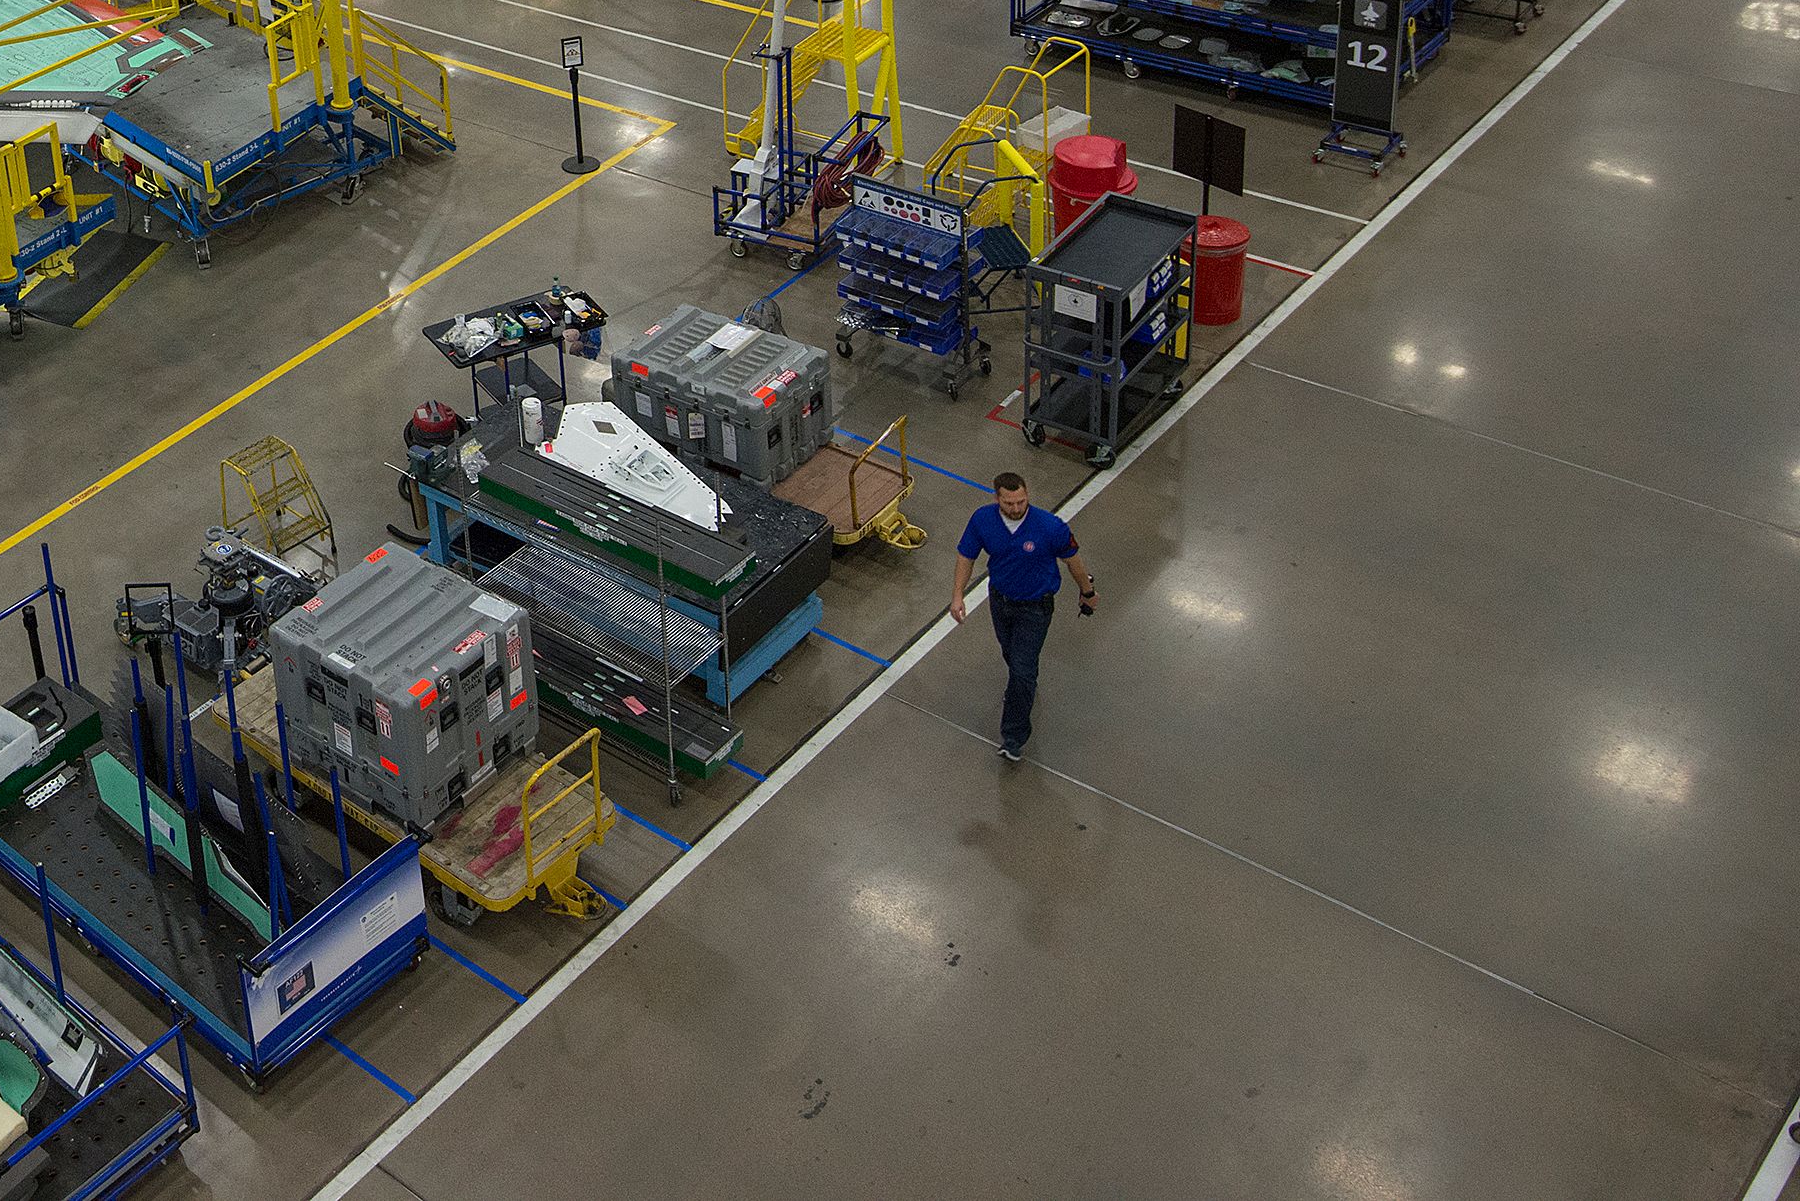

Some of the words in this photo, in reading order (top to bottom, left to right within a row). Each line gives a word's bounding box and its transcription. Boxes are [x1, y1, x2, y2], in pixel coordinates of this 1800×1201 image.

[1347, 41, 1388, 73] 12
[336, 650, 359, 664] STACK
[339, 643, 352, 653] DO
[351, 649, 367, 661] NOT
[323, 677, 334, 687] DO
[333, 682, 348, 696] NOT
[461, 678, 470, 689] DO
[470, 669, 483, 683] NOT
[463, 678, 483, 695] STACK
[327, 686, 348, 701] STACK
